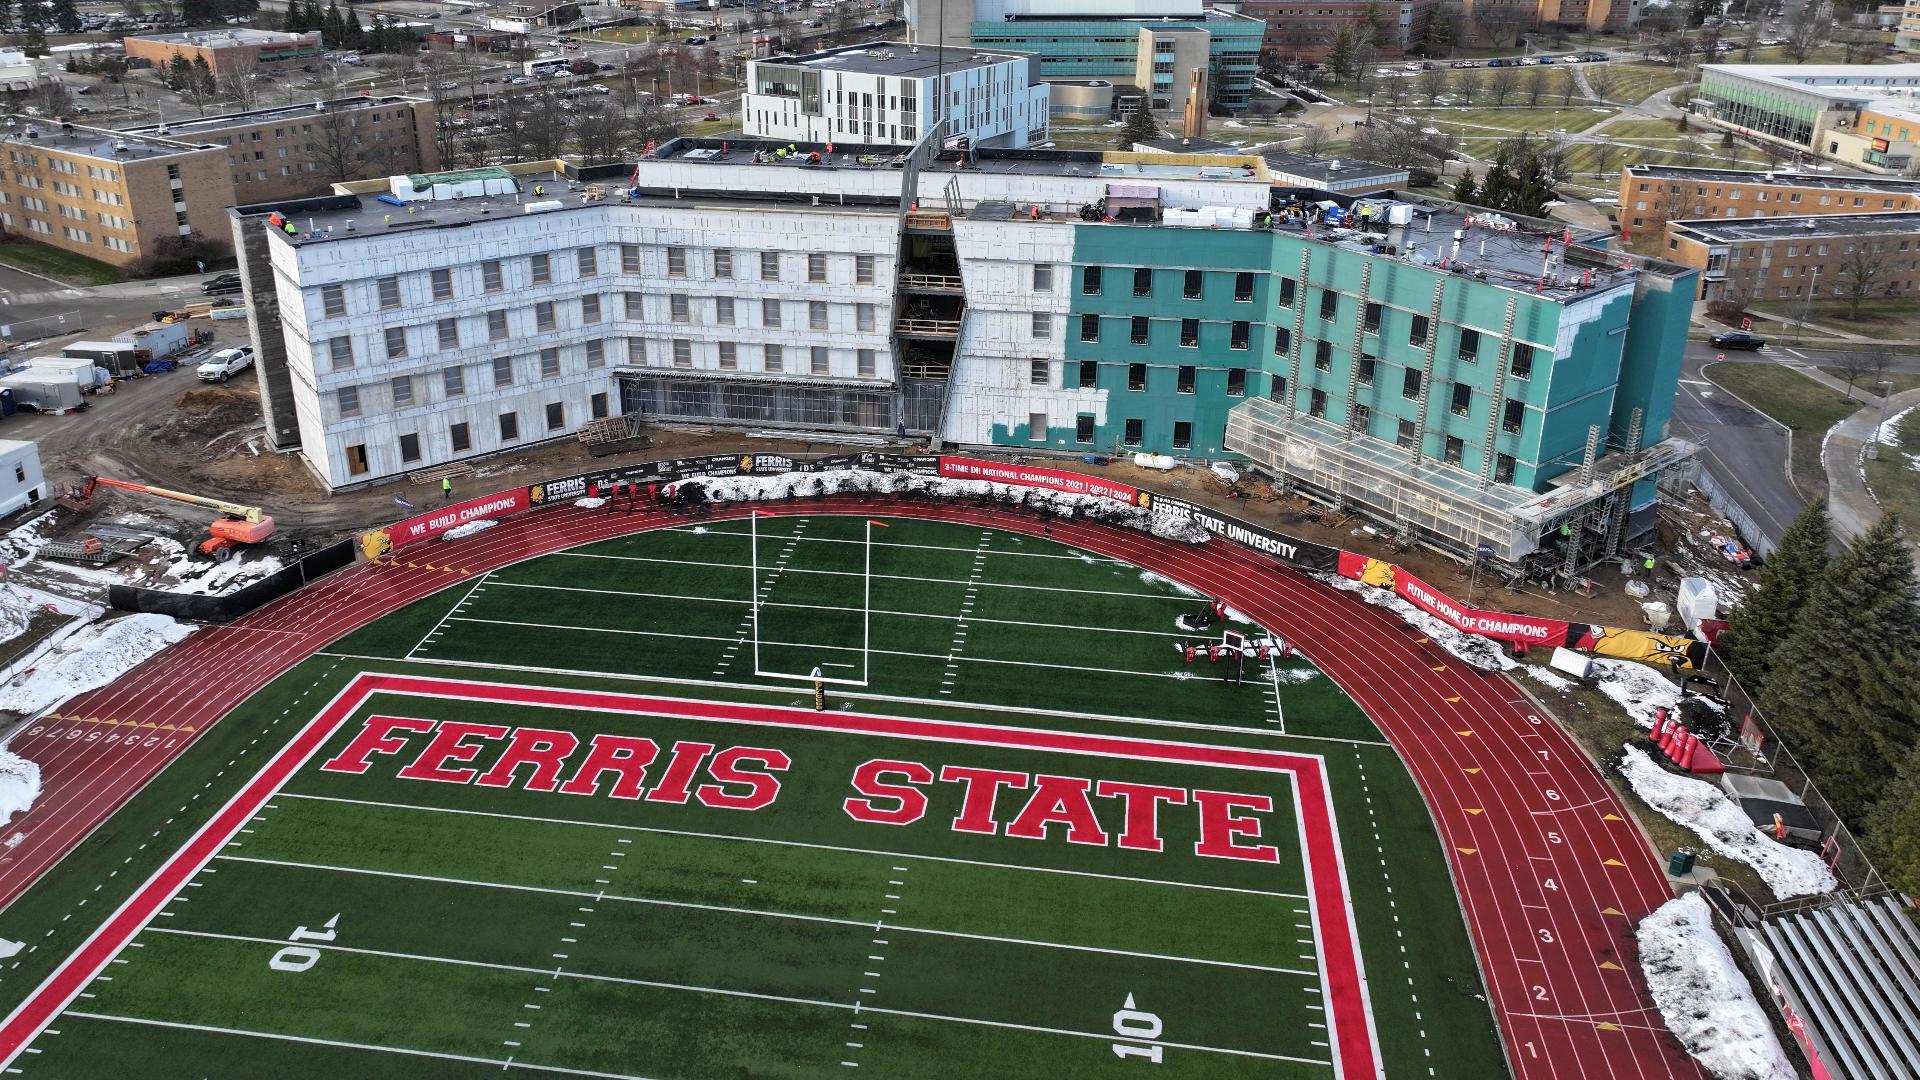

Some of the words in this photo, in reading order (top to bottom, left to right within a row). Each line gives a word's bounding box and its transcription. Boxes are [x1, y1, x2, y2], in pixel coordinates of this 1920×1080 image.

[755, 455, 793, 468] FERRIS
[546, 476, 586, 496] FERRIS
[944, 463, 969, 473] 3-TIME
[982, 468, 1019, 480] NATIONAL
[1020, 472, 1064, 487] CHAMPIONS
[1065, 479, 1084, 491] 2021
[1089, 484, 1109, 497] 2022
[1113, 490, 1133, 502] 2024
[410, 523, 427, 536] WE
[429, 513, 457, 530] BUILD
[460, 497, 516, 520] CHAMPIONS
[1152, 500, 1191, 518] FERRIS
[1193, 512, 1225, 534] STATE
[1227, 523, 1298, 560] UNIVERSITY
[1407, 581, 1437, 609] FUTURE
[1436, 600, 1461, 625] HOME
[1461, 616, 1477, 629] OF
[1478, 618, 1549, 638] CHAMPIONS
[1527, 715, 1541, 726] 8
[28, 725, 45, 736] 8
[47, 728, 64, 738] 7
[85, 731, 102, 742] 5
[104, 733, 121, 744] 4
[124, 735, 141, 746] 3
[143, 736, 161, 747] 2
[164, 738, 177, 749] 1
[1538, 750, 1550, 761] 7
[320, 714, 792, 811] FERRIS
[842, 758, 1280, 864] STATE
[1545, 789, 1560, 801] 6
[1547, 832, 1562, 844] 5
[1544, 878, 1558, 892] 4
[1538, 928, 1554, 943] 3
[269, 926, 337, 972] 10
[1532, 985, 1549, 1001] 2
[1112, 1009, 1163, 1064] 10
[1525, 1042, 1537, 1059] 1
